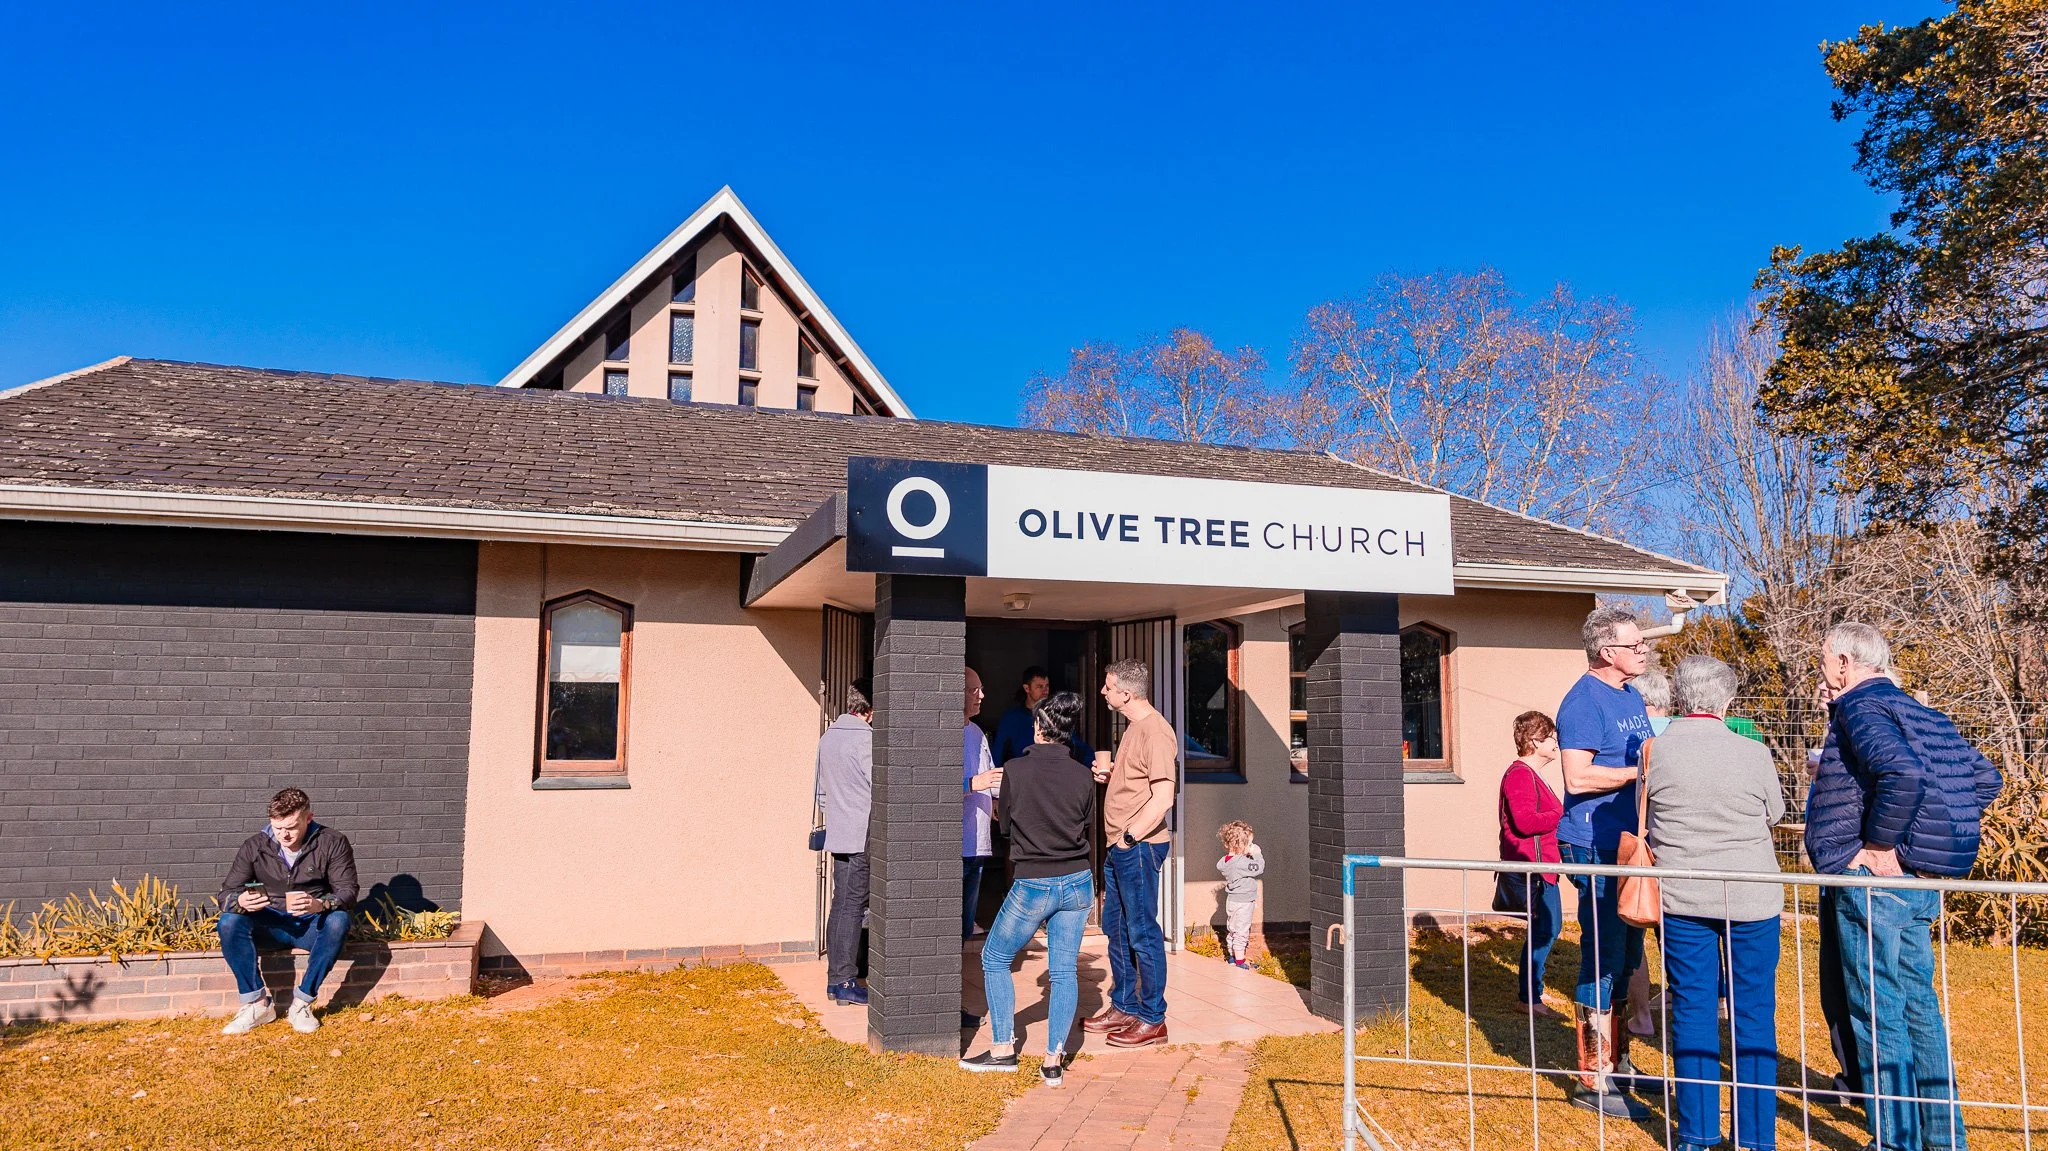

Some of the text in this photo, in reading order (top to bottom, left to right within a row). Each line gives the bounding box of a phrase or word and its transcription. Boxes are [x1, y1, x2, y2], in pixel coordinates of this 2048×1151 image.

[1018, 508, 1425, 557] OLIVE TREE CHURCH
[1616, 714, 1648, 733] MADE
